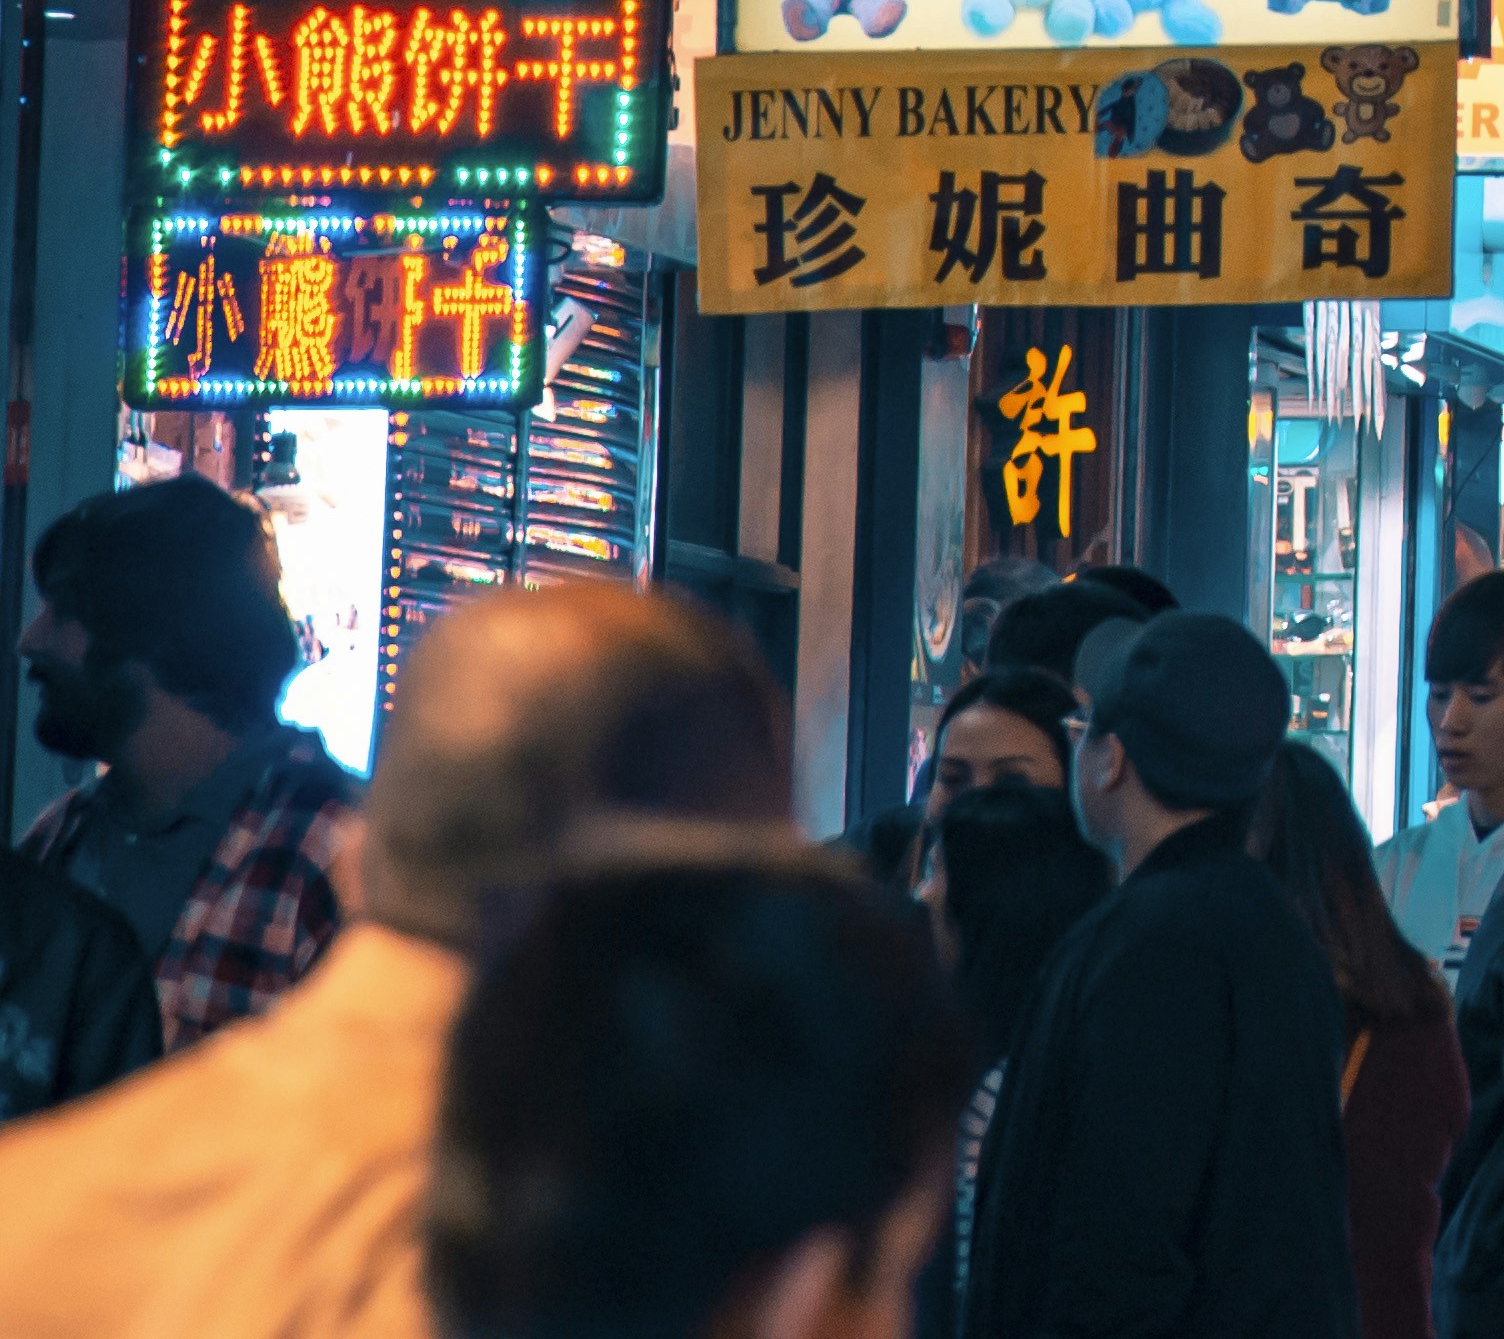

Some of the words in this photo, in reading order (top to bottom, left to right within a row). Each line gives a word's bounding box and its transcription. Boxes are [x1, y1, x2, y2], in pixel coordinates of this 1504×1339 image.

[722, 84, 884, 145] JENNY
[896, 79, 1100, 140] BAKERY
[750, 163, 1407, 287] 珍妮曲奇
